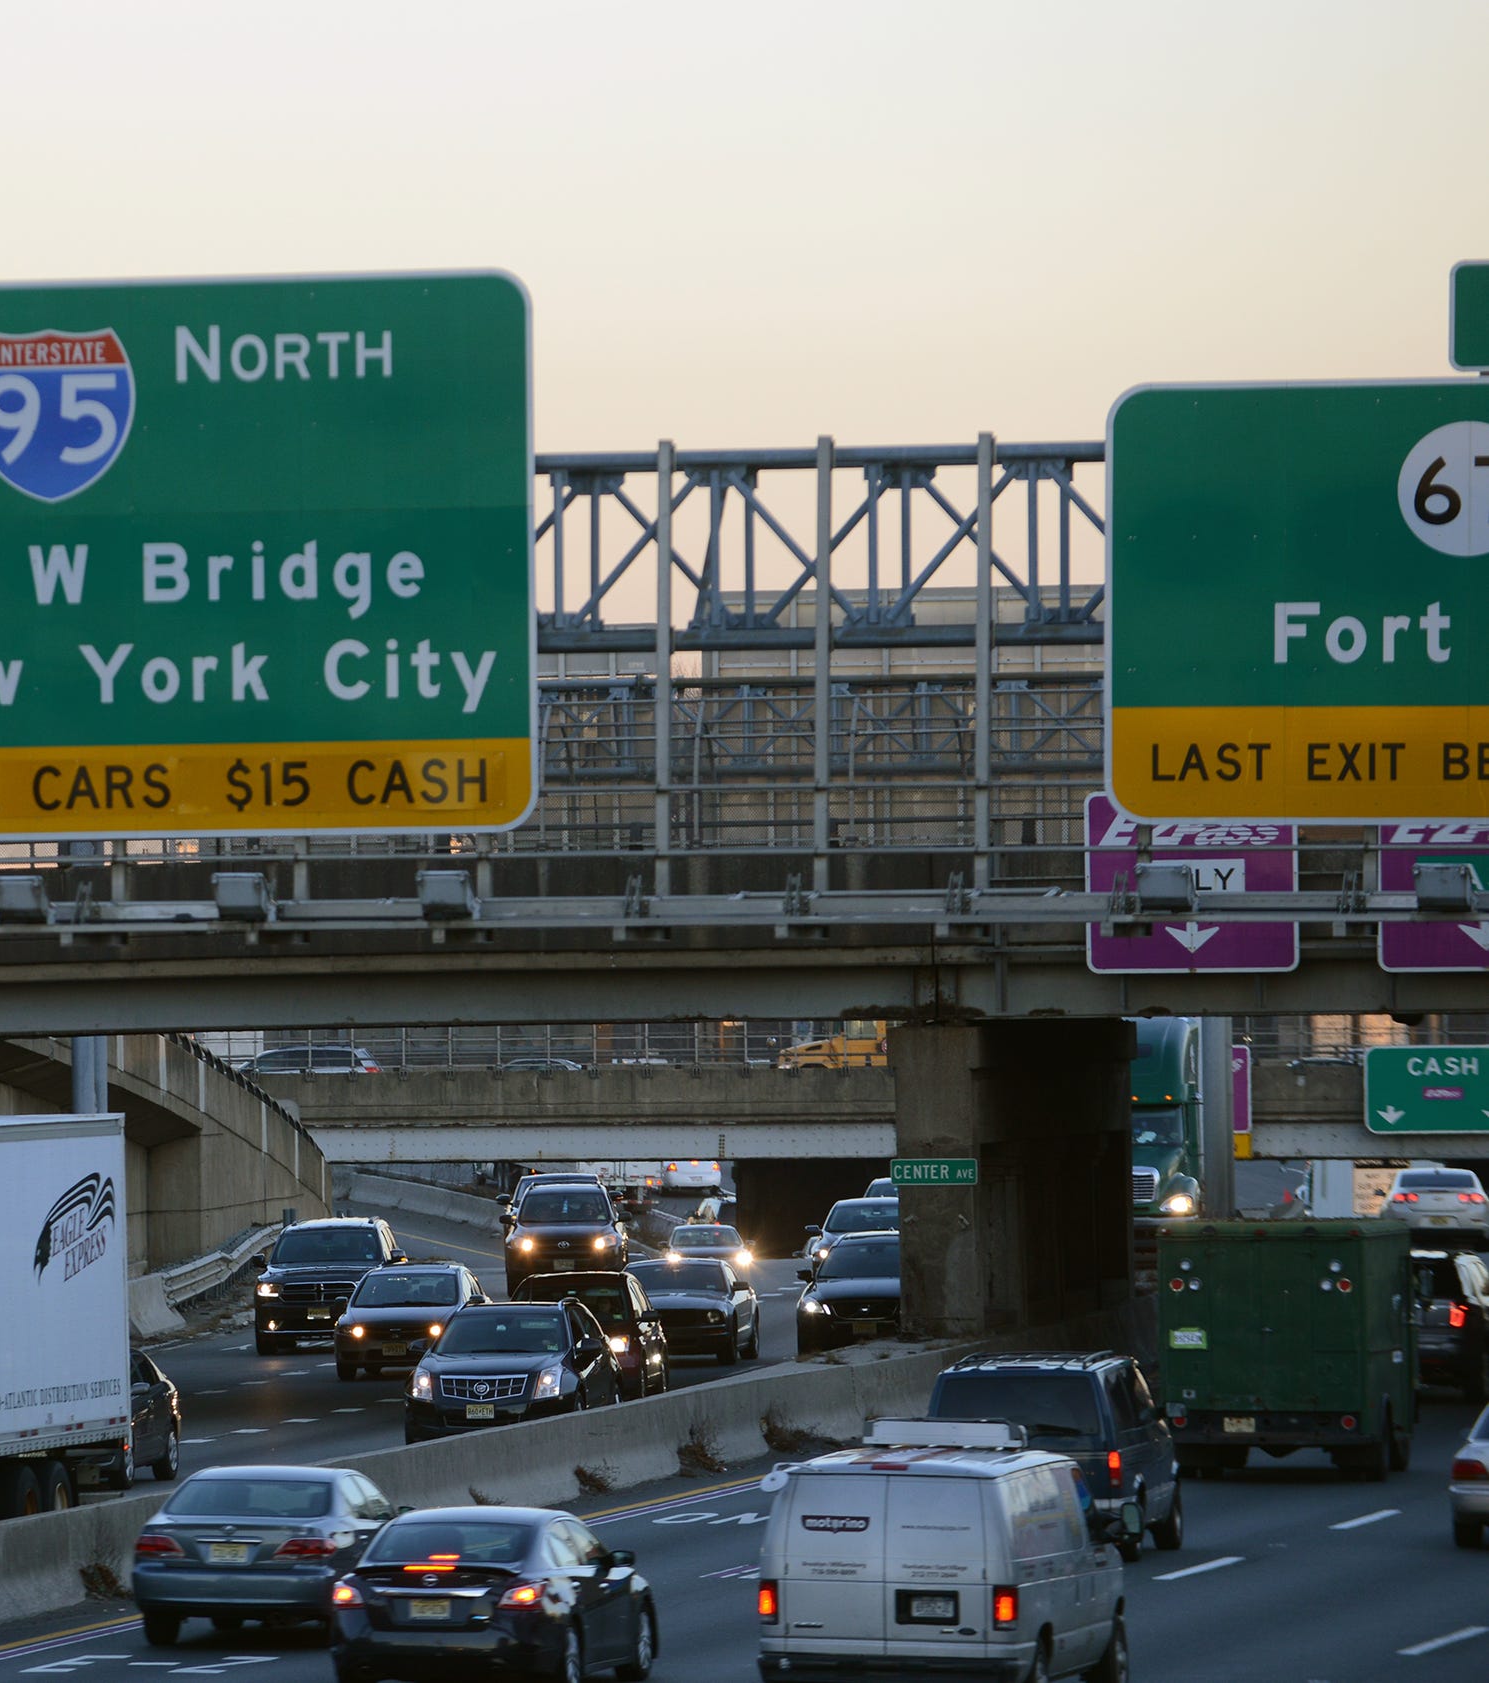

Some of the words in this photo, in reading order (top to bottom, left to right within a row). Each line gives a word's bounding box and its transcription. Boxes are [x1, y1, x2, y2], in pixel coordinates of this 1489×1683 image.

[175, 325, 393, 383] NORTH
[28, 543, 89, 605] W
[142, 540, 425, 619] Bridge
[1273, 600, 1453, 664] Fort
[79, 643, 270, 704] York
[323, 638, 498, 714] City
[32, 764, 172, 811] CARS
[225, 758, 311, 812] $15
[346, 757, 489, 806] CASH
[1151, 741, 1272, 782] LAST
[1308, 741, 1407, 782] EXIT
[1195, 867, 1235, 891] LY
[1407, 1056, 1479, 1076] CASH
[894, 1164, 950, 1180] CENTER
[956, 1168, 975, 1179] AVE
[51, 1207, 86, 1257] EAGLE
[63, 1224, 107, 1282] EXPRESS
[40, 1382, 89, 1406] DISTRIBUTION
[90, 1378, 122, 1400] SERVICES
